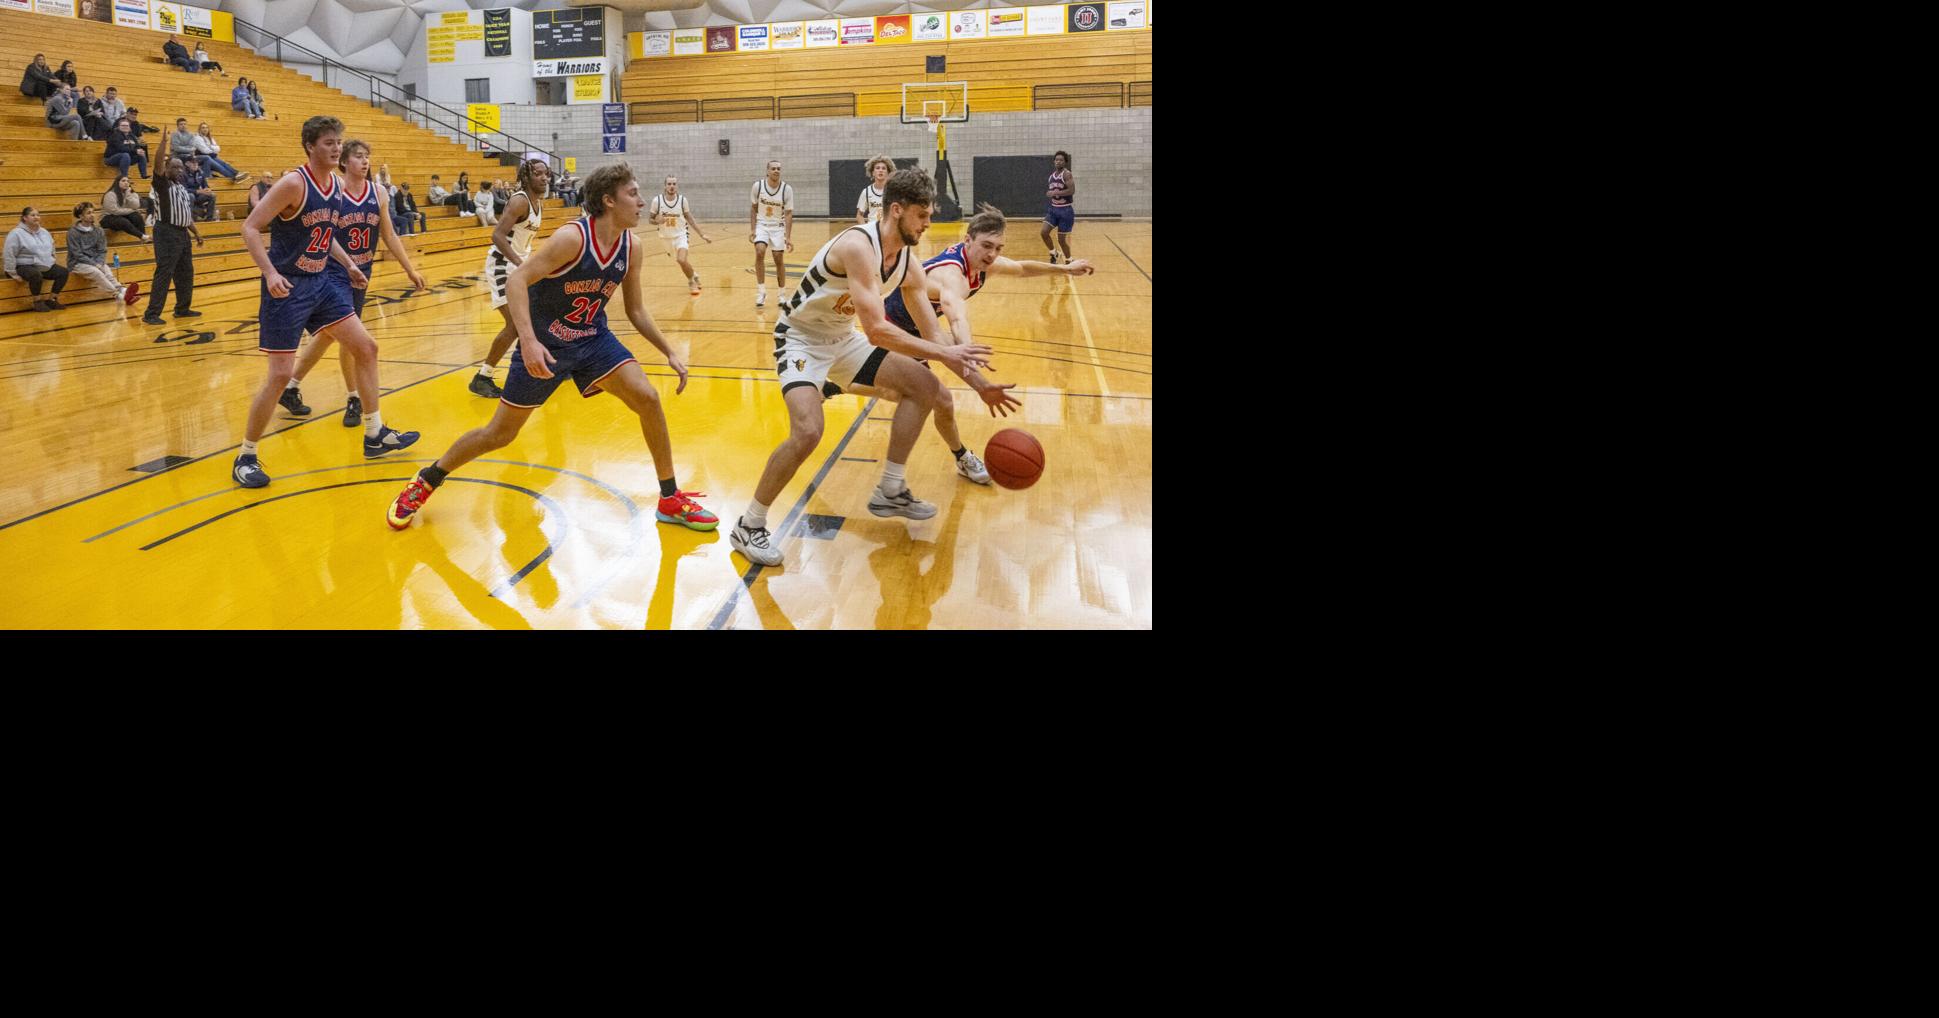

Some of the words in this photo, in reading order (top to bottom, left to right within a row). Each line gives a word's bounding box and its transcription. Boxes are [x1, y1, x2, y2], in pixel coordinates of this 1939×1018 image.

[556, 61, 602, 75] WARRIORS
[306, 226, 333, 253] 24
[348, 227, 371, 251] 31
[564, 296, 602, 325] 21
